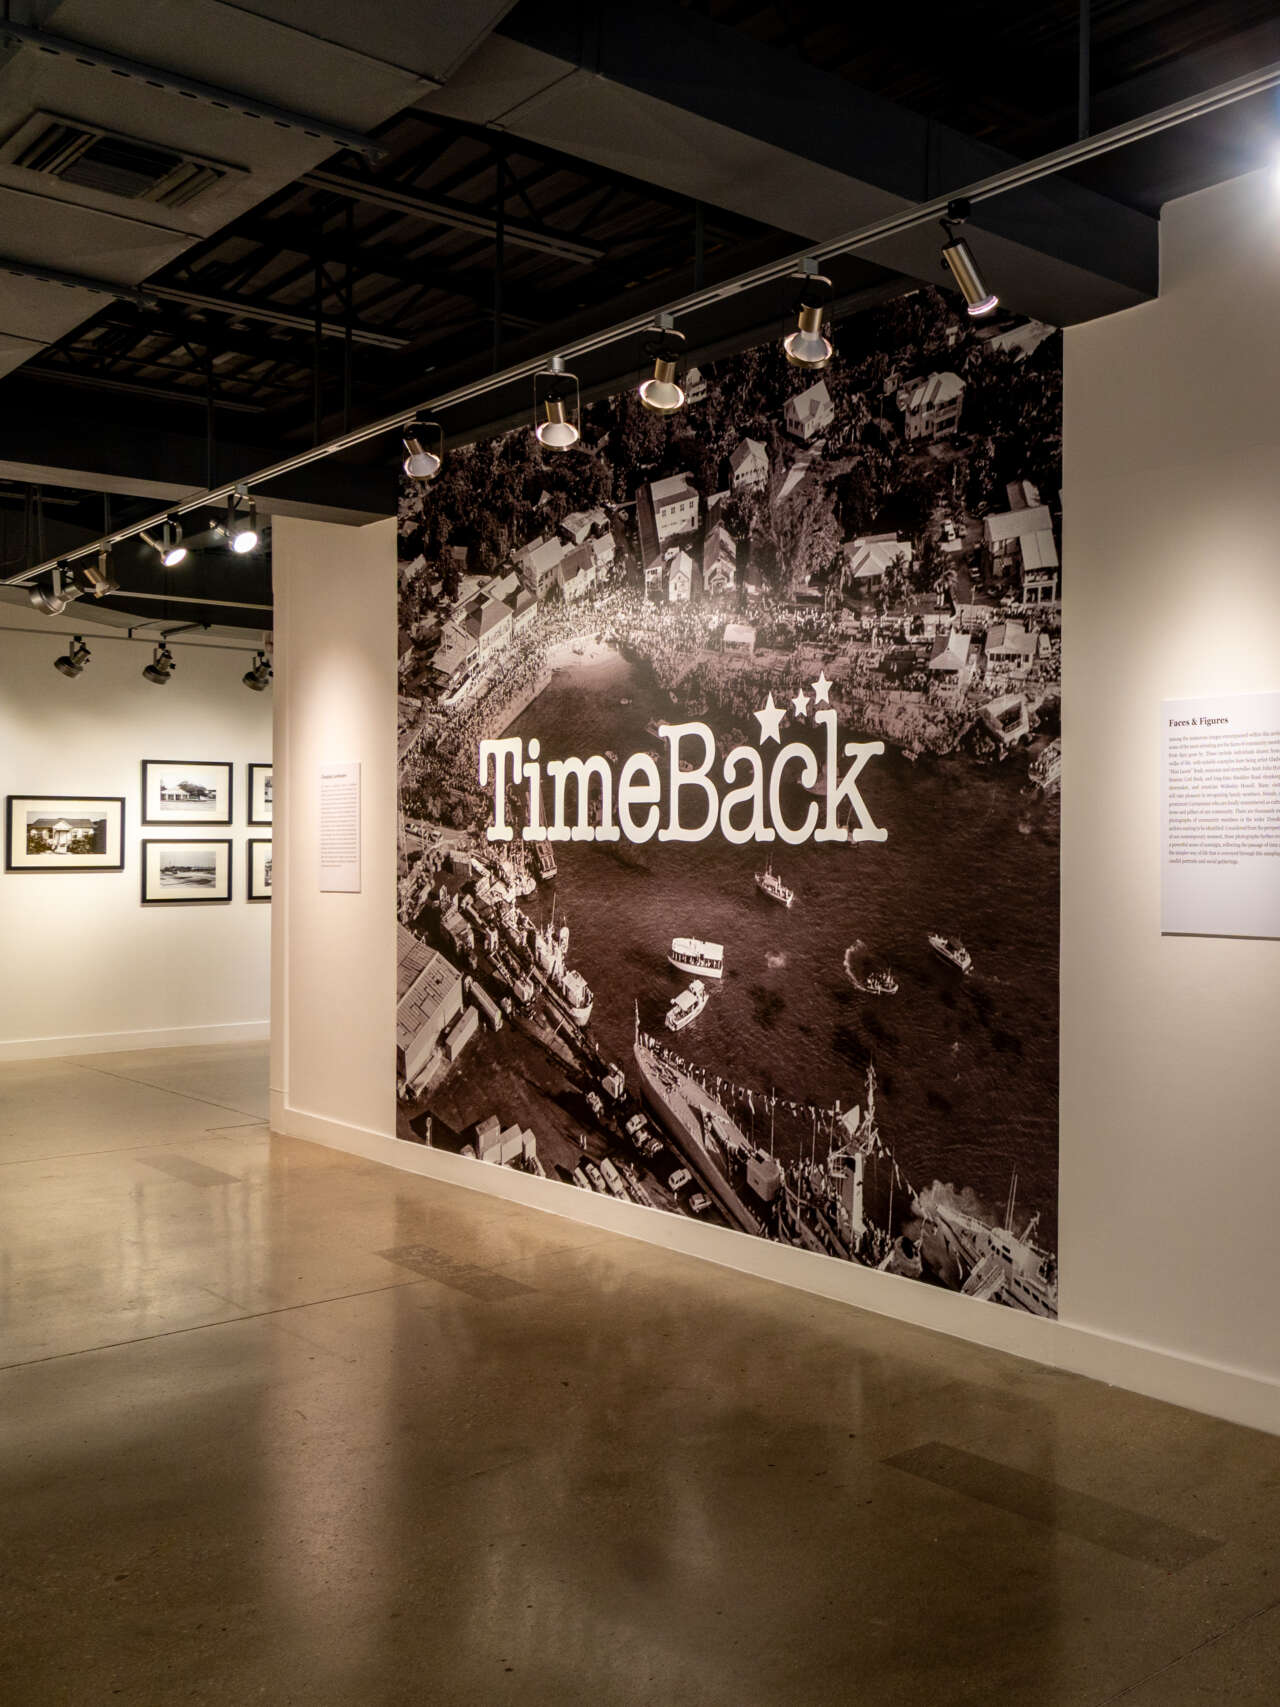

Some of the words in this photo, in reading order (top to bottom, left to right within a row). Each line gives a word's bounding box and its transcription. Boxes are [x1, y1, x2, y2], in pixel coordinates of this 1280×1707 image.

[1169, 719, 1190, 727] Faces
[1191, 718, 1198, 726] &
[1200, 716, 1229, 727] Figures
[479, 709, 888, 844] TimeBack
